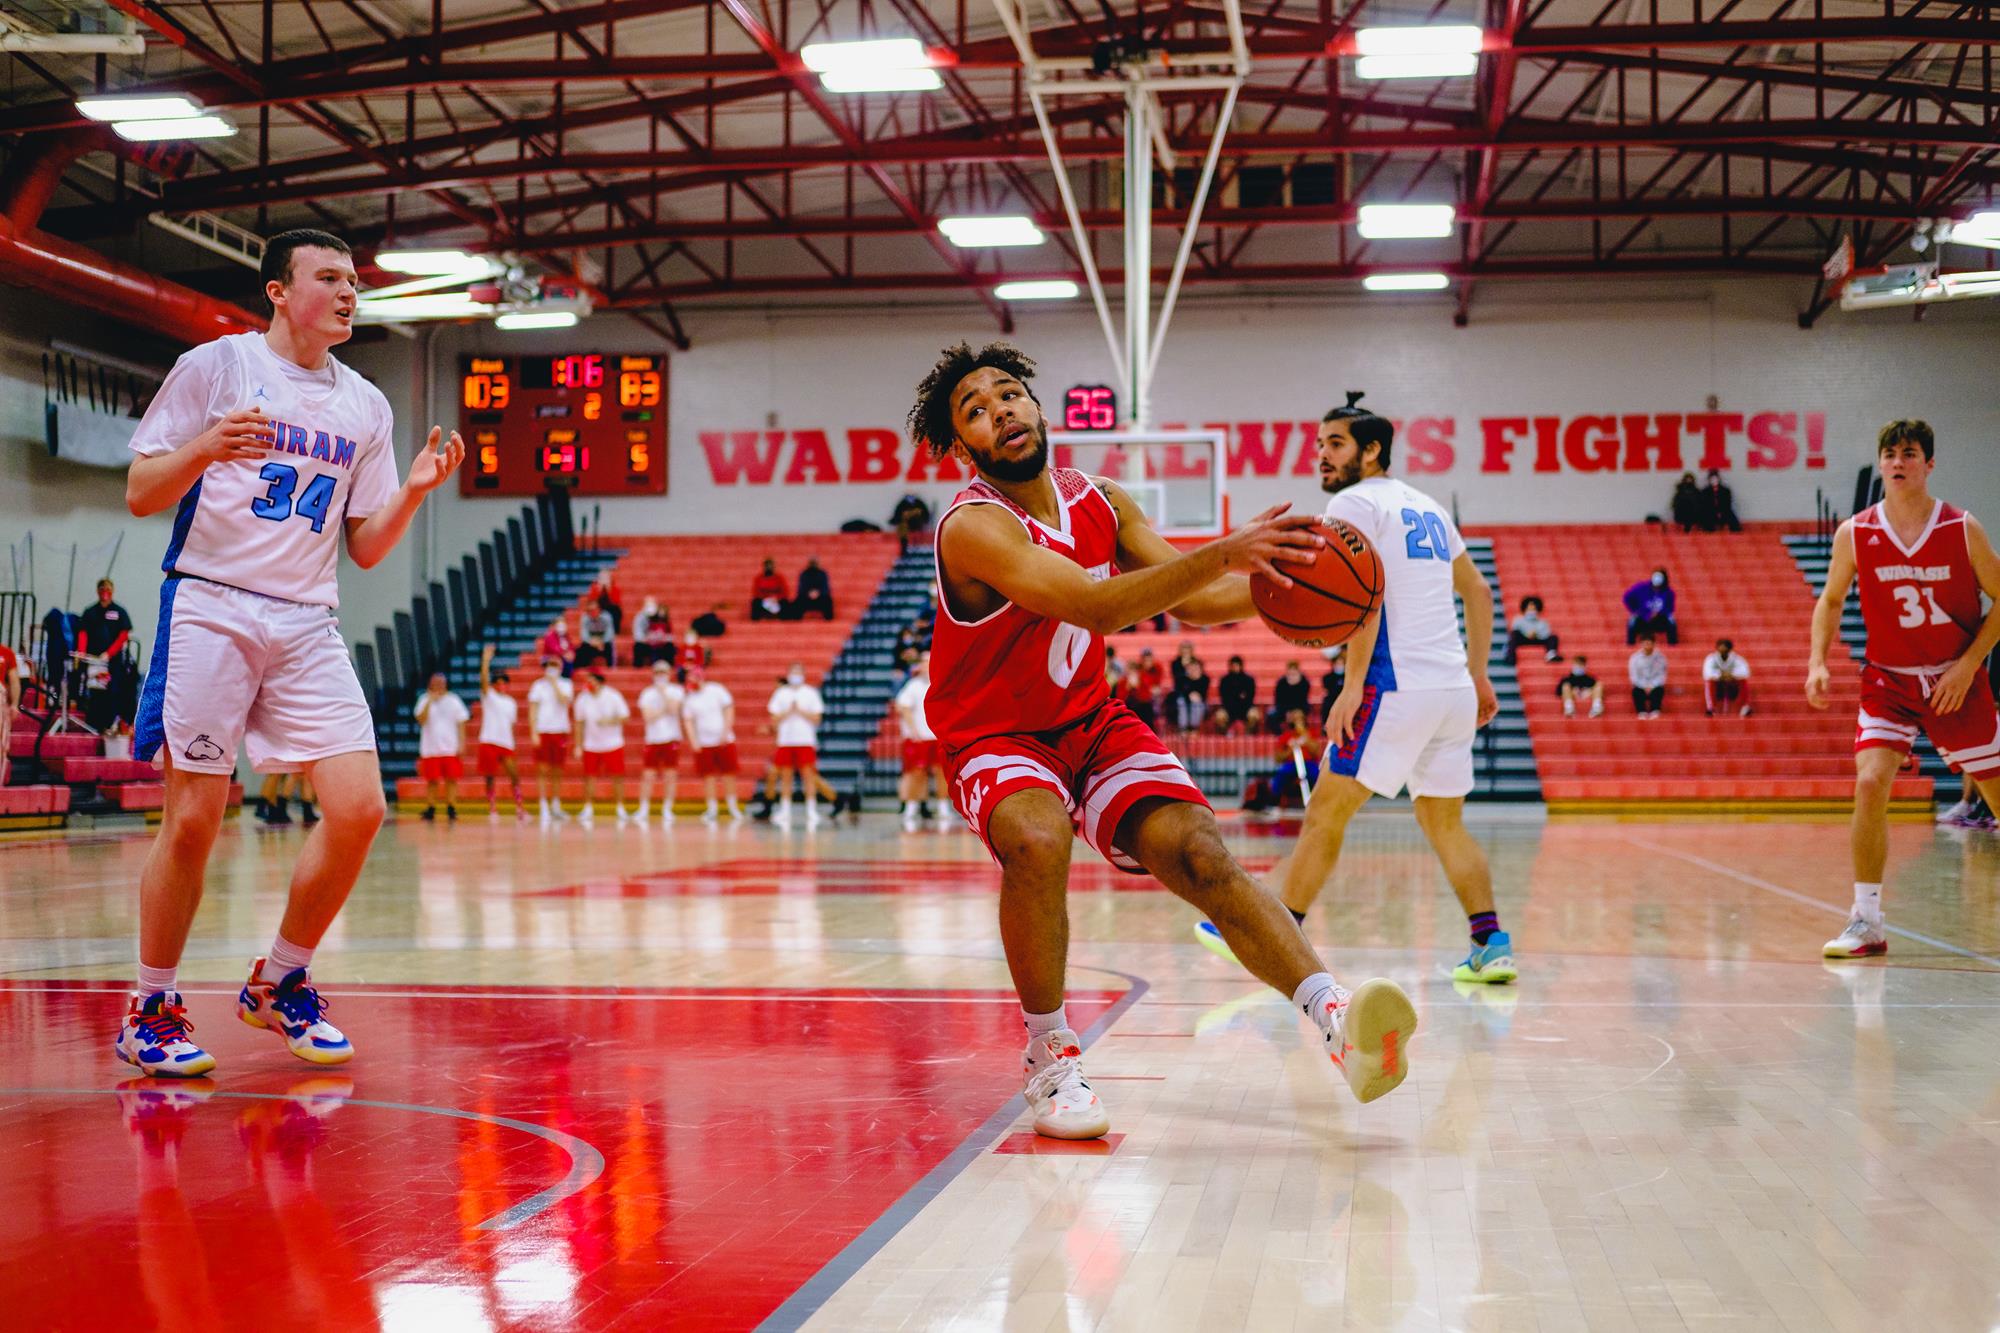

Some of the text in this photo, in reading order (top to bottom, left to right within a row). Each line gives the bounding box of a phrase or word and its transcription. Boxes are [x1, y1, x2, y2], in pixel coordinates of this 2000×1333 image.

[464, 375, 509, 408] 103
[584, 392, 601, 420] 2
[620, 371, 660, 406] 83
[1067, 388, 1114, 429] 26
[481, 446, 498, 473] 5
[631, 444, 649, 472] 5
[697, 411, 1826, 485] WABA ALWS FIGHTS!
[251, 462, 337, 534] 34
[1401, 507, 1450, 563] 20
[1893, 585, 1952, 629] 31
[1048, 620, 1092, 689] 0
